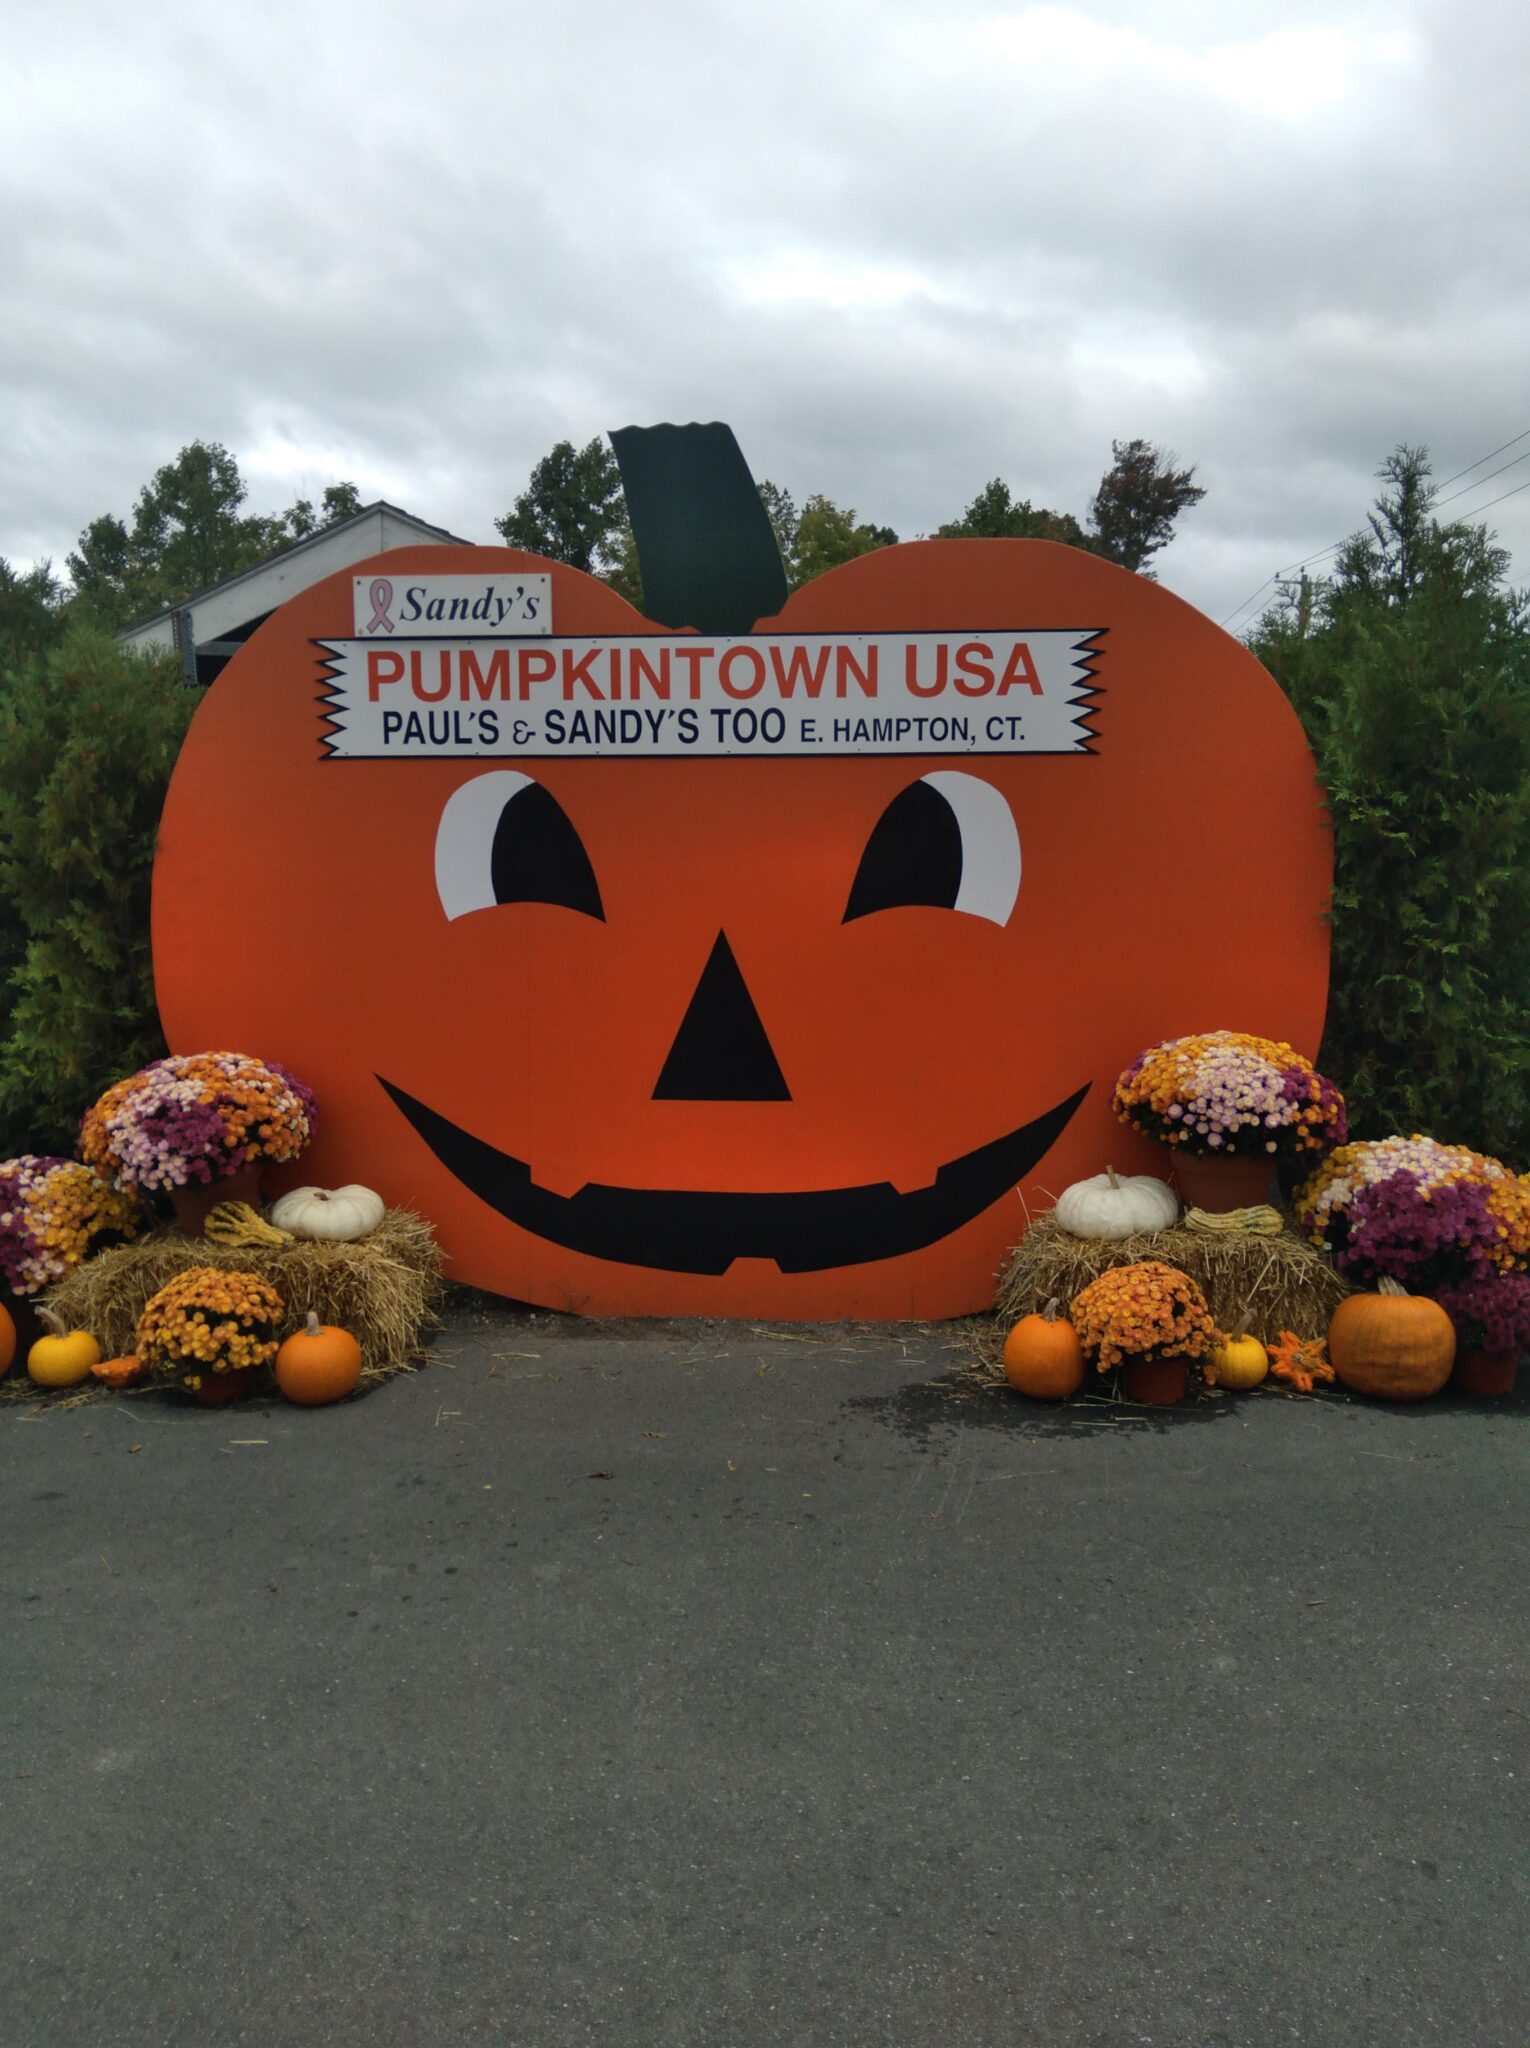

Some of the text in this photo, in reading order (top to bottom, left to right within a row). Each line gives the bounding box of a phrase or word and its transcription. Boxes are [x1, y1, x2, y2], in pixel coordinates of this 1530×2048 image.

[400, 586, 541, 628] Sandy's
[366, 642, 1045, 703] PUMPKINTOWN USA
[382, 707, 1026, 745] PAUL'S & SANDY'S TOO E. HAMPTON, CT.
